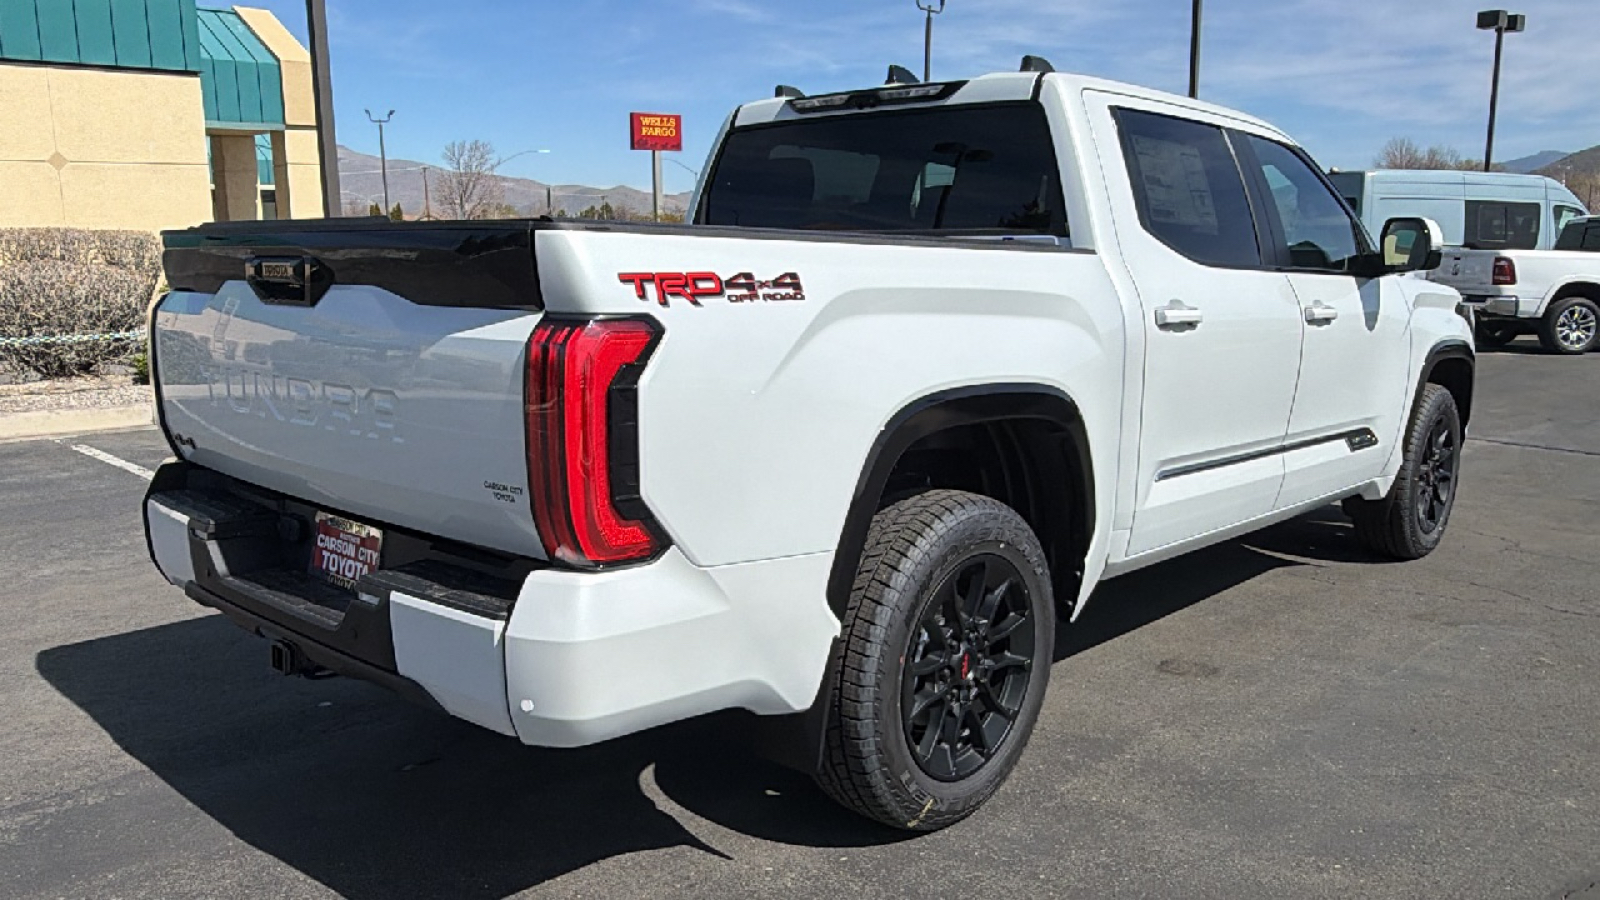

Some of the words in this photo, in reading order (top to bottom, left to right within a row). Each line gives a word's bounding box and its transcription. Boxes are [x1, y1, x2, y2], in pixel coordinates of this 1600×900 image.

[640, 116, 676, 127] WELLS
[641, 127, 676, 137] FARGO
[264, 264, 289, 277] TOYOTA
[618, 272, 726, 307] TRD
[727, 294, 760, 303] OFF
[762, 293, 805, 302] ROAD
[202, 366, 405, 443] TUNDRA
[317, 533, 356, 557] CARSON
[359, 546, 379, 565] CITY
[321, 549, 369, 580] TOYOTA
